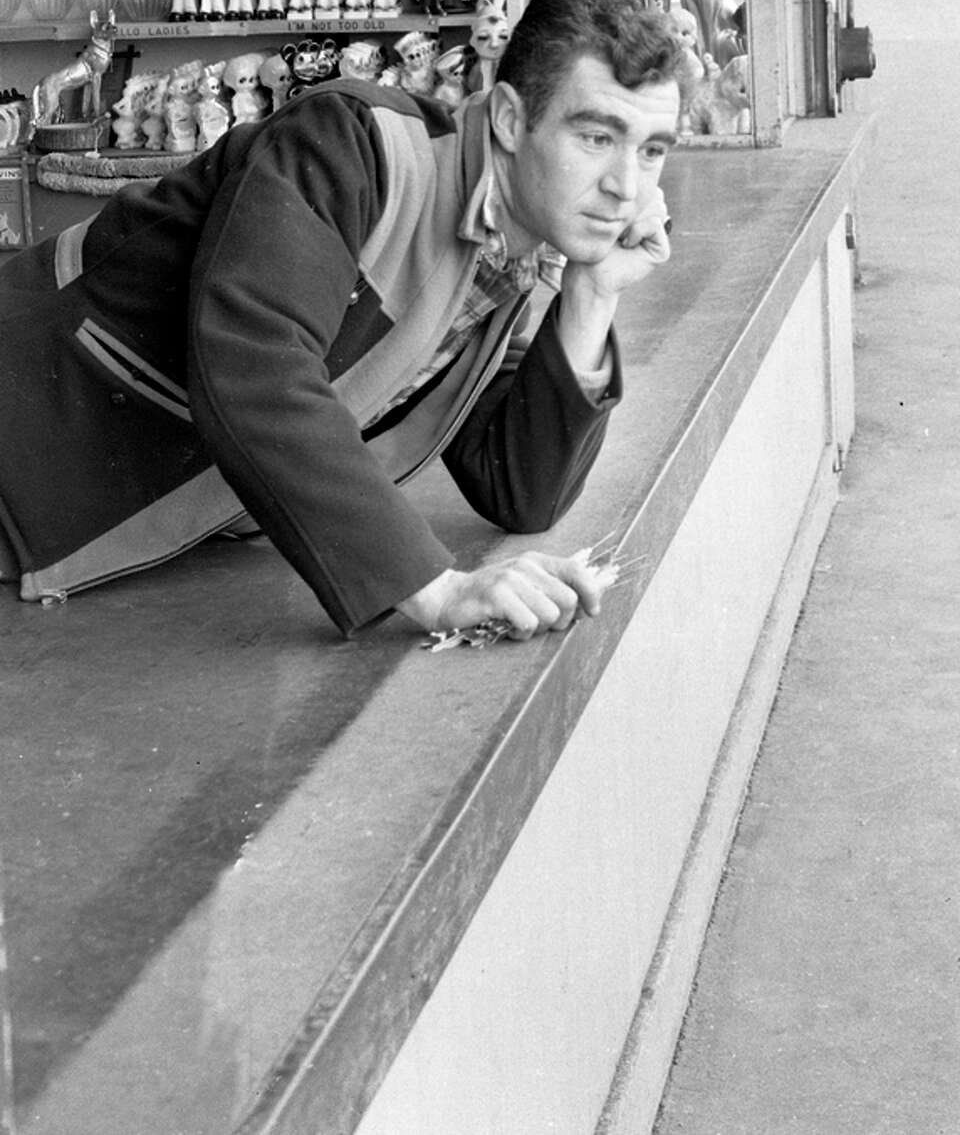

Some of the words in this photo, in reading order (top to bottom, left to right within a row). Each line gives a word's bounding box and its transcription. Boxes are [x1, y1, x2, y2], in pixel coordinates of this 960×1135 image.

[287, 21, 305, 31] I'M
[311, 21, 332, 31] NOT
[338, 20, 359, 30] TOO
[363, 19, 385, 29] OLD
[148, 26, 190, 36] LADIES
